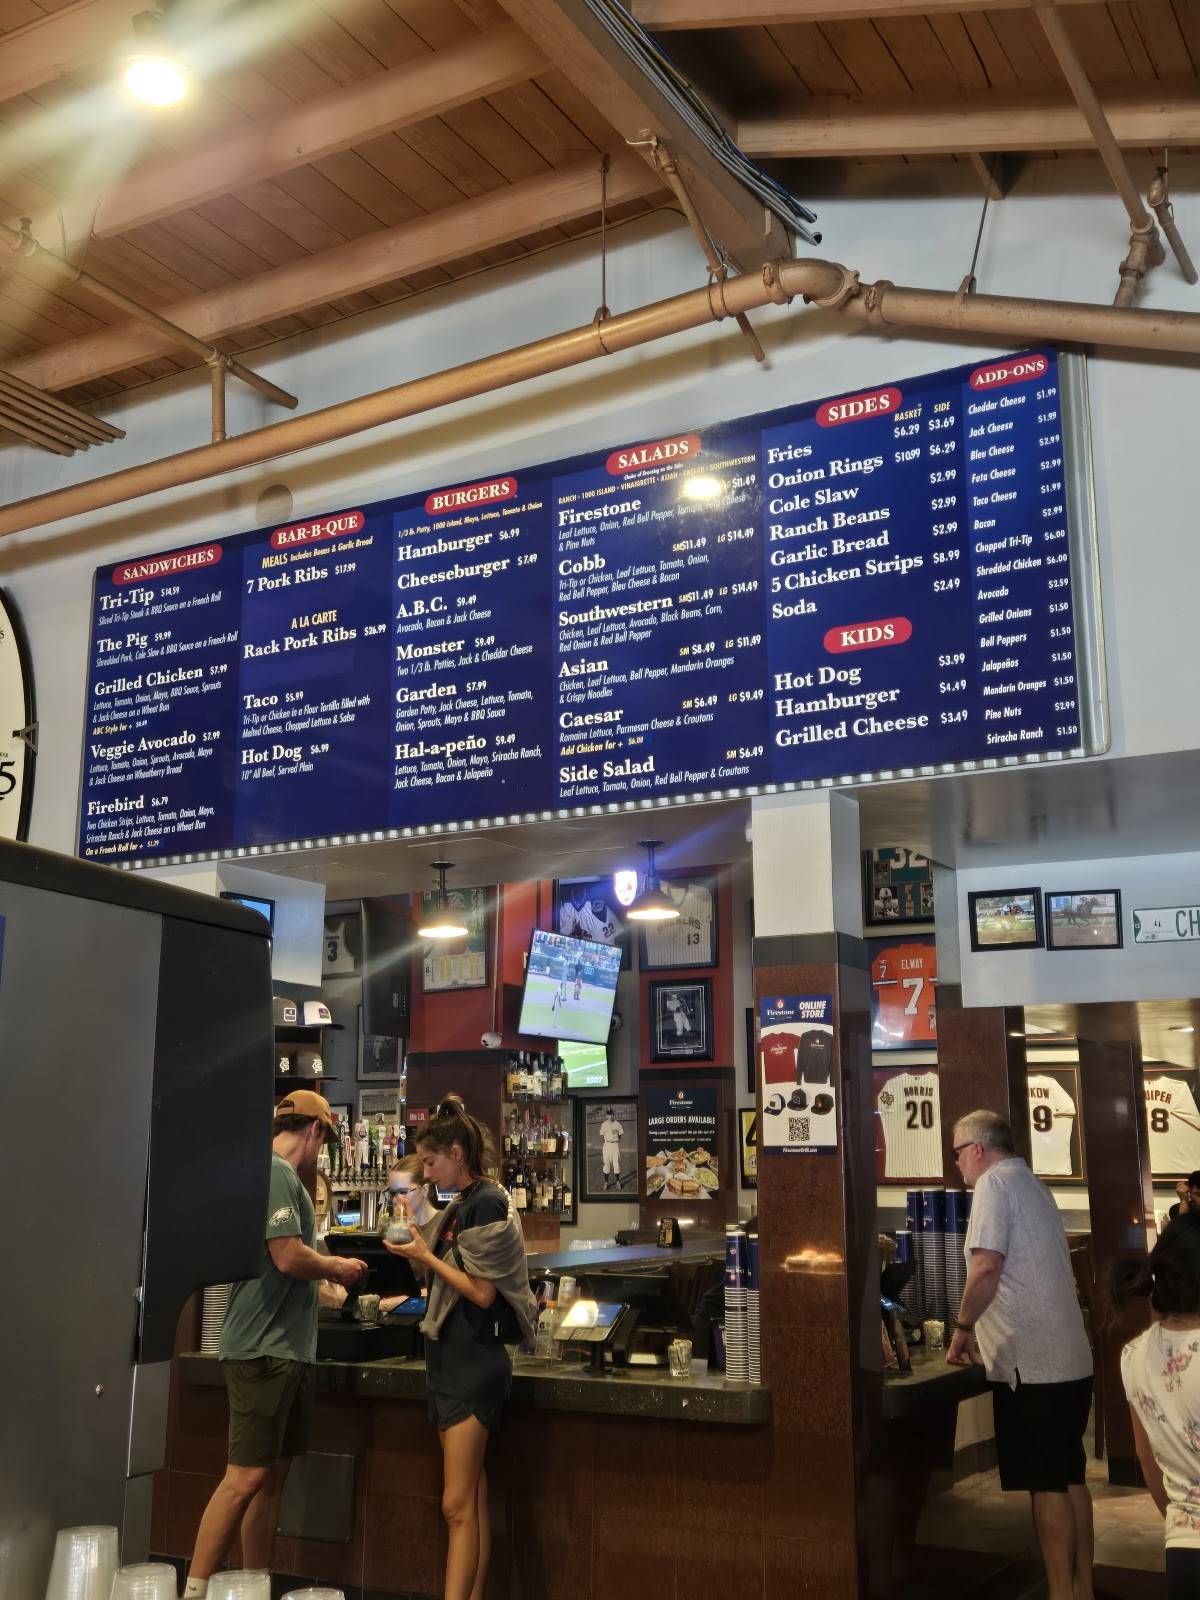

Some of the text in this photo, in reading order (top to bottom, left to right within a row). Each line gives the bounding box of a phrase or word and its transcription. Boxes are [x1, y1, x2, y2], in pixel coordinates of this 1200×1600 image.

[975, 360, 1045, 386] ADD-ONS
[828, 394, 890, 422] SIDES
[894, 401, 951, 422] BASKET SIDE
[968, 387, 1057, 415] Cheddar Cheese $1.99
[767, 415, 955, 464] Fries $6.29 $3.69
[970, 434, 1060, 461] Bleu Cheese $2.99
[618, 440, 689, 469] SALADS
[768, 440, 956, 489] Onion Rings $10.99 $6.29
[432, 481, 510, 510] BURGERS
[558, 474, 756, 527] Firestone $11.49
[769, 469, 957, 515] Cole Slaw $2.99
[972, 482, 1061, 507] Taco Cheese $1.99
[277, 515, 358, 545] BAR-B-QUE
[769, 495, 957, 541] Ranch Beans $2.99
[973, 505, 1063, 530] Bacon $2.99
[397, 527, 520, 562] Hamburger $6.99
[558, 527, 755, 576] Cobb LG $14.49
[770, 521, 958, 566] Garlic Bread $2.99
[975, 529, 1065, 554] Chopped Tri-Tip $6.00
[123, 549, 214, 580] SANDWICHES
[261, 552, 288, 569] MEALS
[397, 553, 538, 590] Cheeseburger $7.49
[771, 549, 960, 593] 5 Chicken Strips $8.99
[976, 553, 1068, 577] Shredded Chicken $6.00
[246, 562, 356, 594] 7 Pork Ribs $17.99
[977, 578, 1069, 601] Avocado $2.59
[99, 587, 155, 611] Tri-Tip
[395, 594, 477, 619] A.B.C. $9.49
[558, 580, 758, 627] Southwestern LG $14.49
[772, 577, 961, 619] Soda $2.49
[291, 609, 337, 630] A LA CARTE
[396, 609, 492, 634] Avocado, Bacon & Jack Cheese
[96, 630, 172, 653] The Pig $9.99
[243, 623, 387, 659] Rack Pork Ribs $26.99
[395, 635, 495, 661] Monster $9.49
[840, 623, 895, 647] KIDS
[980, 626, 1071, 648] Bell Peppers $1.50
[557, 634, 761, 678] Asian SM $8.49 LG $11.49
[981, 651, 1072, 673] Jalapeños $1.50
[94, 663, 228, 696] Grilled Chicken $7.99
[773, 652, 965, 691] Hot Dog $3.99
[395, 680, 487, 703] Garden $7.99
[774, 679, 967, 717] Hamburger $4.49
[983, 675, 1074, 696] Mandarin Oranges $1.50
[243, 690, 304, 710] Taco $5.99
[559, 689, 764, 729] Caesar SM $6.49 LG $9.49
[775, 709, 968, 747] Grilled Cheese $3.49
[986, 725, 1077, 745] Sriracha Ranch $1.50
[90, 730, 221, 761] Veggie Avocado $7.99
[241, 743, 330, 765] Hot Dog $6.99
[394, 733, 516, 760] Hal-a-peño $9.49
[559, 745, 764, 783] Side Salad SM $6.49
[87, 794, 169, 816] Firebird $6.79
[602, 922, 616, 939] 22
[1175, 909, 1200, 938] CH
[327, 940, 338, 962] 3
[687, 932, 700, 946] 13
[901, 958, 924, 970] ELWAY
[799, 1000, 827, 1010] ONLINE
[902, 977, 925, 1016] 7
[767, 1009, 795, 1017] Firestone
[801, 1009, 825, 1019] STORE
[903, 1086, 934, 1097] NORRIS
[648, 1115, 716, 1126] LARGE ORDERS AVAILABLE
[905, 1100, 934, 1130] 20
[1032, 1105, 1053, 1133] 9
[1151, 1107, 1170, 1133] 8
